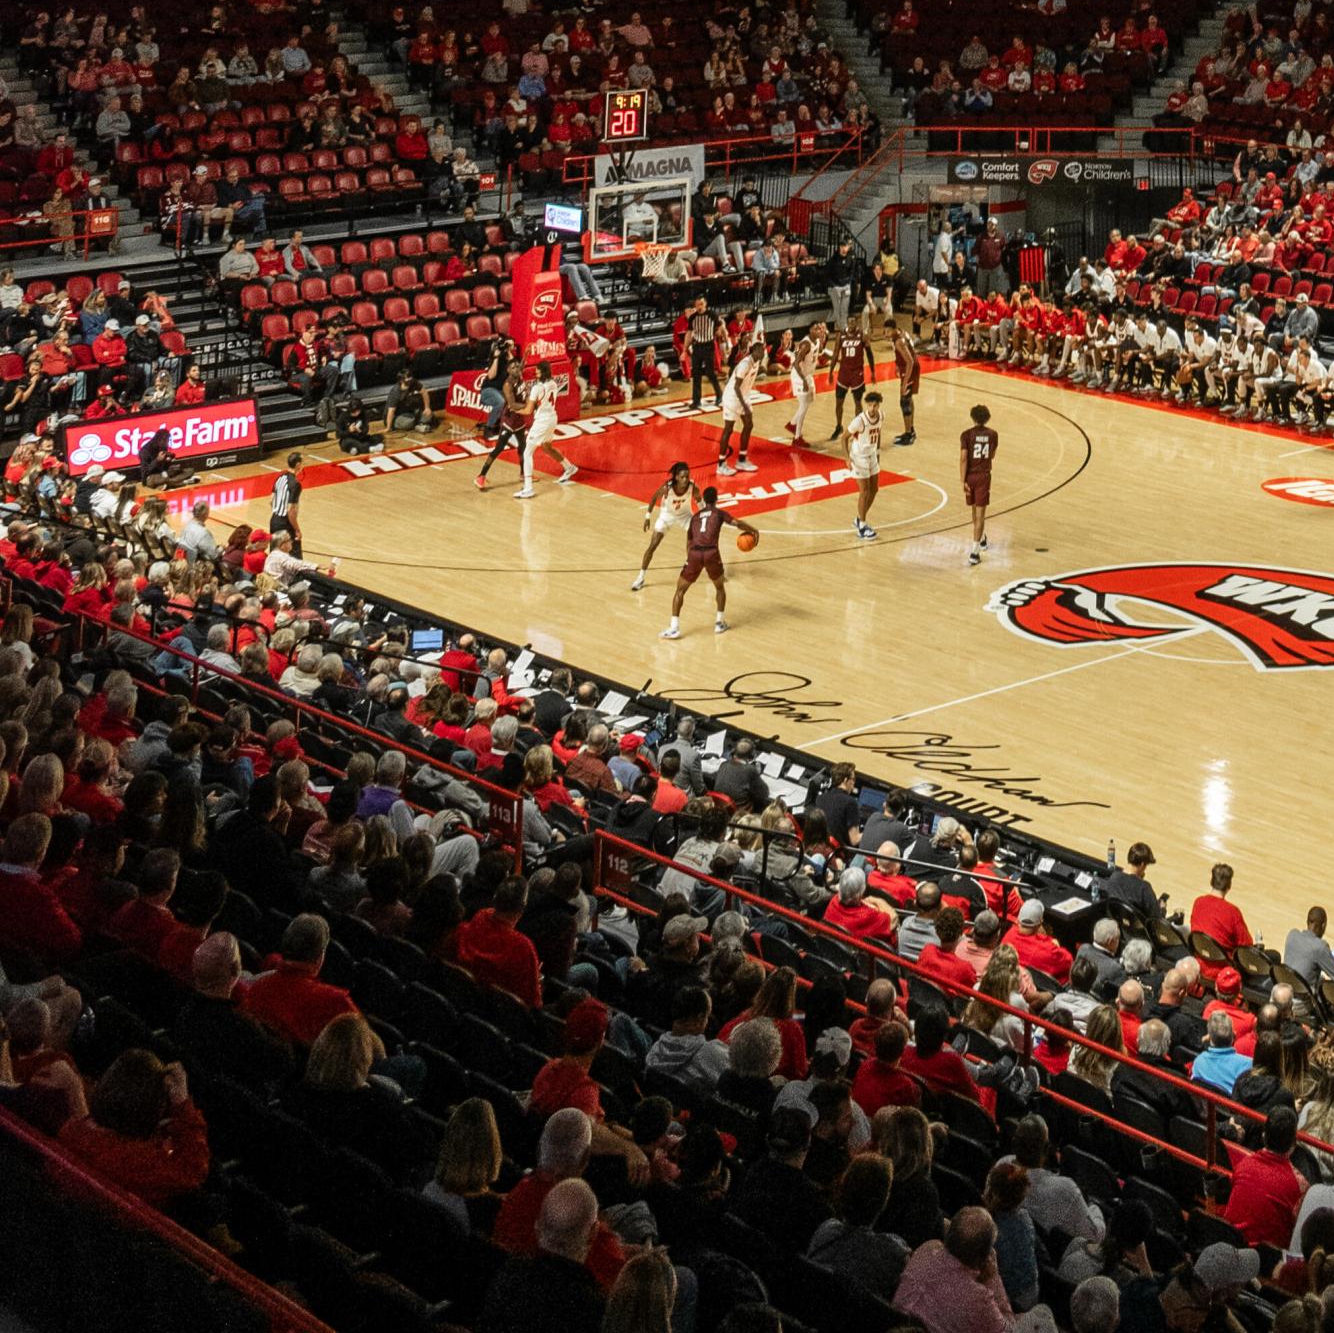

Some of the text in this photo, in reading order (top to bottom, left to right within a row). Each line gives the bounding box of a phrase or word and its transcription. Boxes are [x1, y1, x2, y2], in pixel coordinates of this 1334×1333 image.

[616, 94, 641, 109] 9:19
[611, 110, 636, 136] 20
[627, 156, 694, 179] MAGNA
[981, 161, 1020, 172] Comfort
[982, 171, 1020, 182] Keepers
[1084, 169, 1131, 181] Children's
[973, 443, 990, 459] 24
[492, 805, 511, 823] 113
[607, 854, 628, 873] 112
